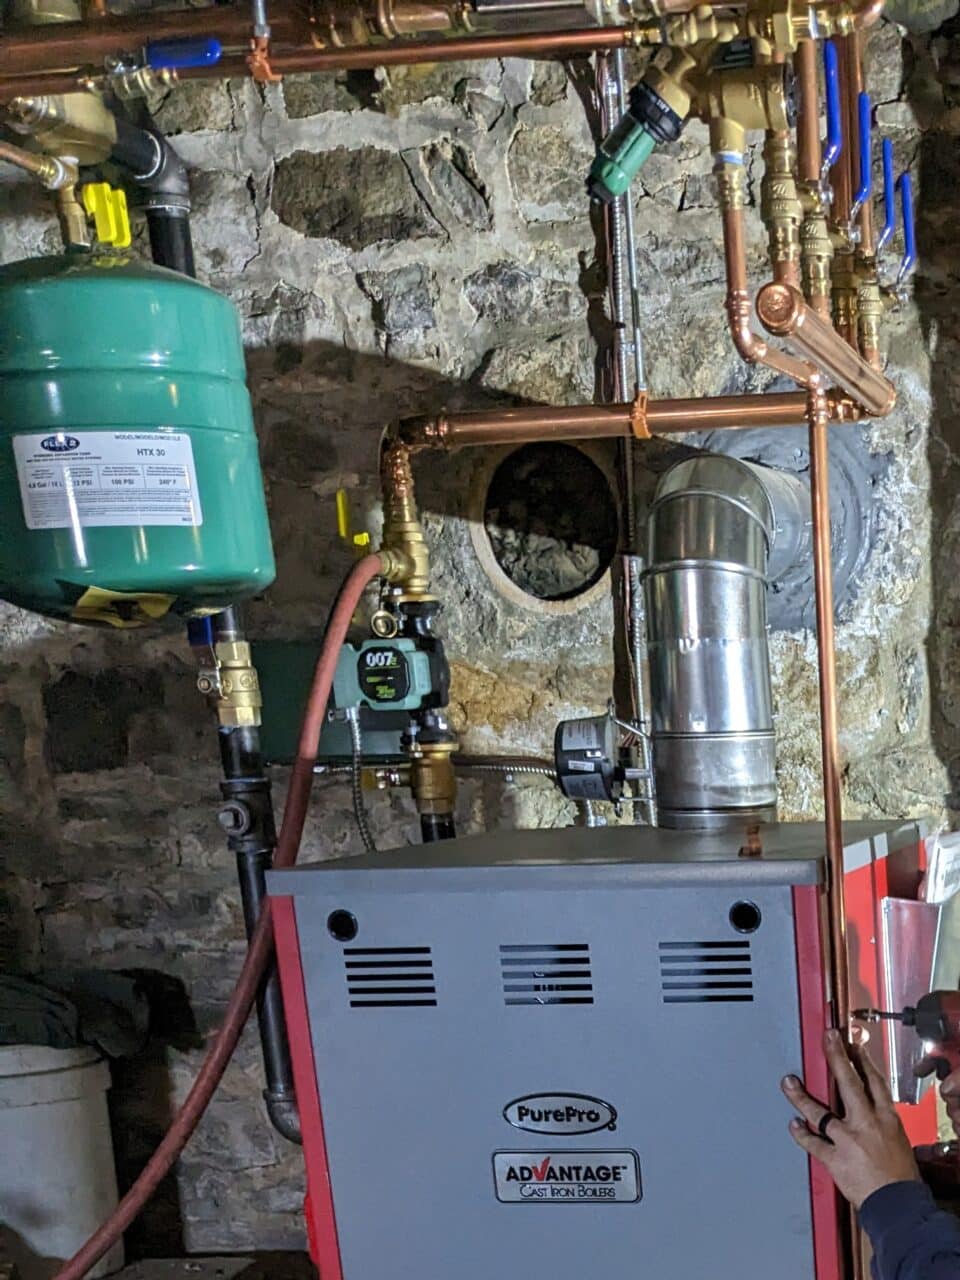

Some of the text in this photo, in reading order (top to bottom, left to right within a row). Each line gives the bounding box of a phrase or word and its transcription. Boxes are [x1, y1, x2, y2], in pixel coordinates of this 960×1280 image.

[137, 448, 166, 457] HTX 30
[517, 1105, 601, 1123] PurePro
[519, 1184, 616, 1198] CAST IRON BOILERS
